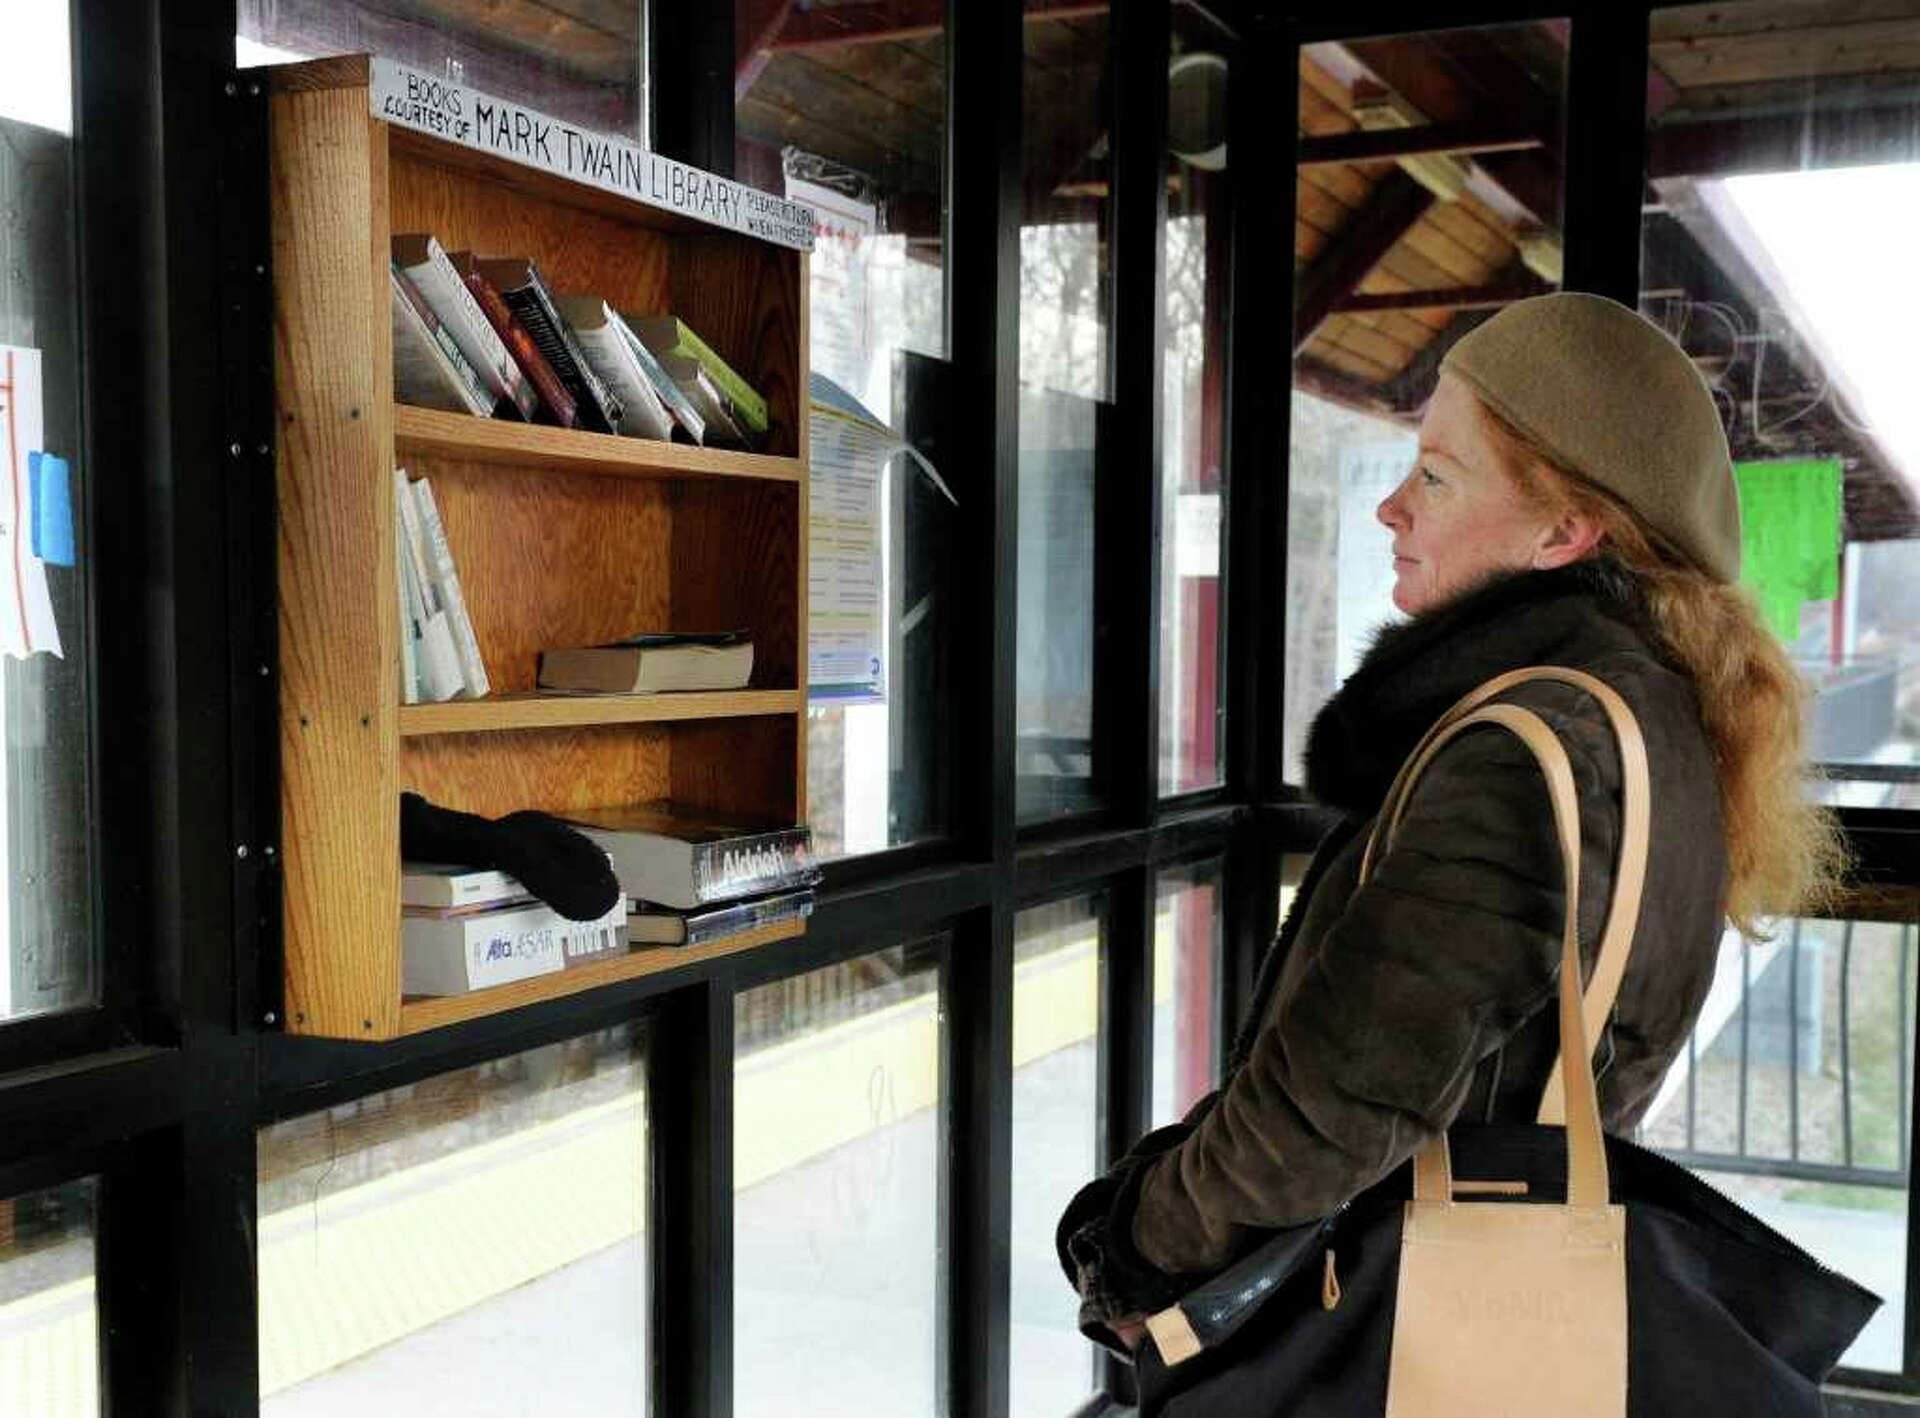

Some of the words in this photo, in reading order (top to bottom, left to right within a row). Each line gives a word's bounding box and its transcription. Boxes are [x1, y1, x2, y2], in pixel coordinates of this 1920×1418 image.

[384, 94, 450, 134] COURTESY
[455, 117, 471, 140] OF
[407, 73, 462, 116] BOOKS
[475, 100, 552, 166] MARK
[562, 129, 641, 192] TWAIN
[651, 157, 742, 226] LIBRARY
